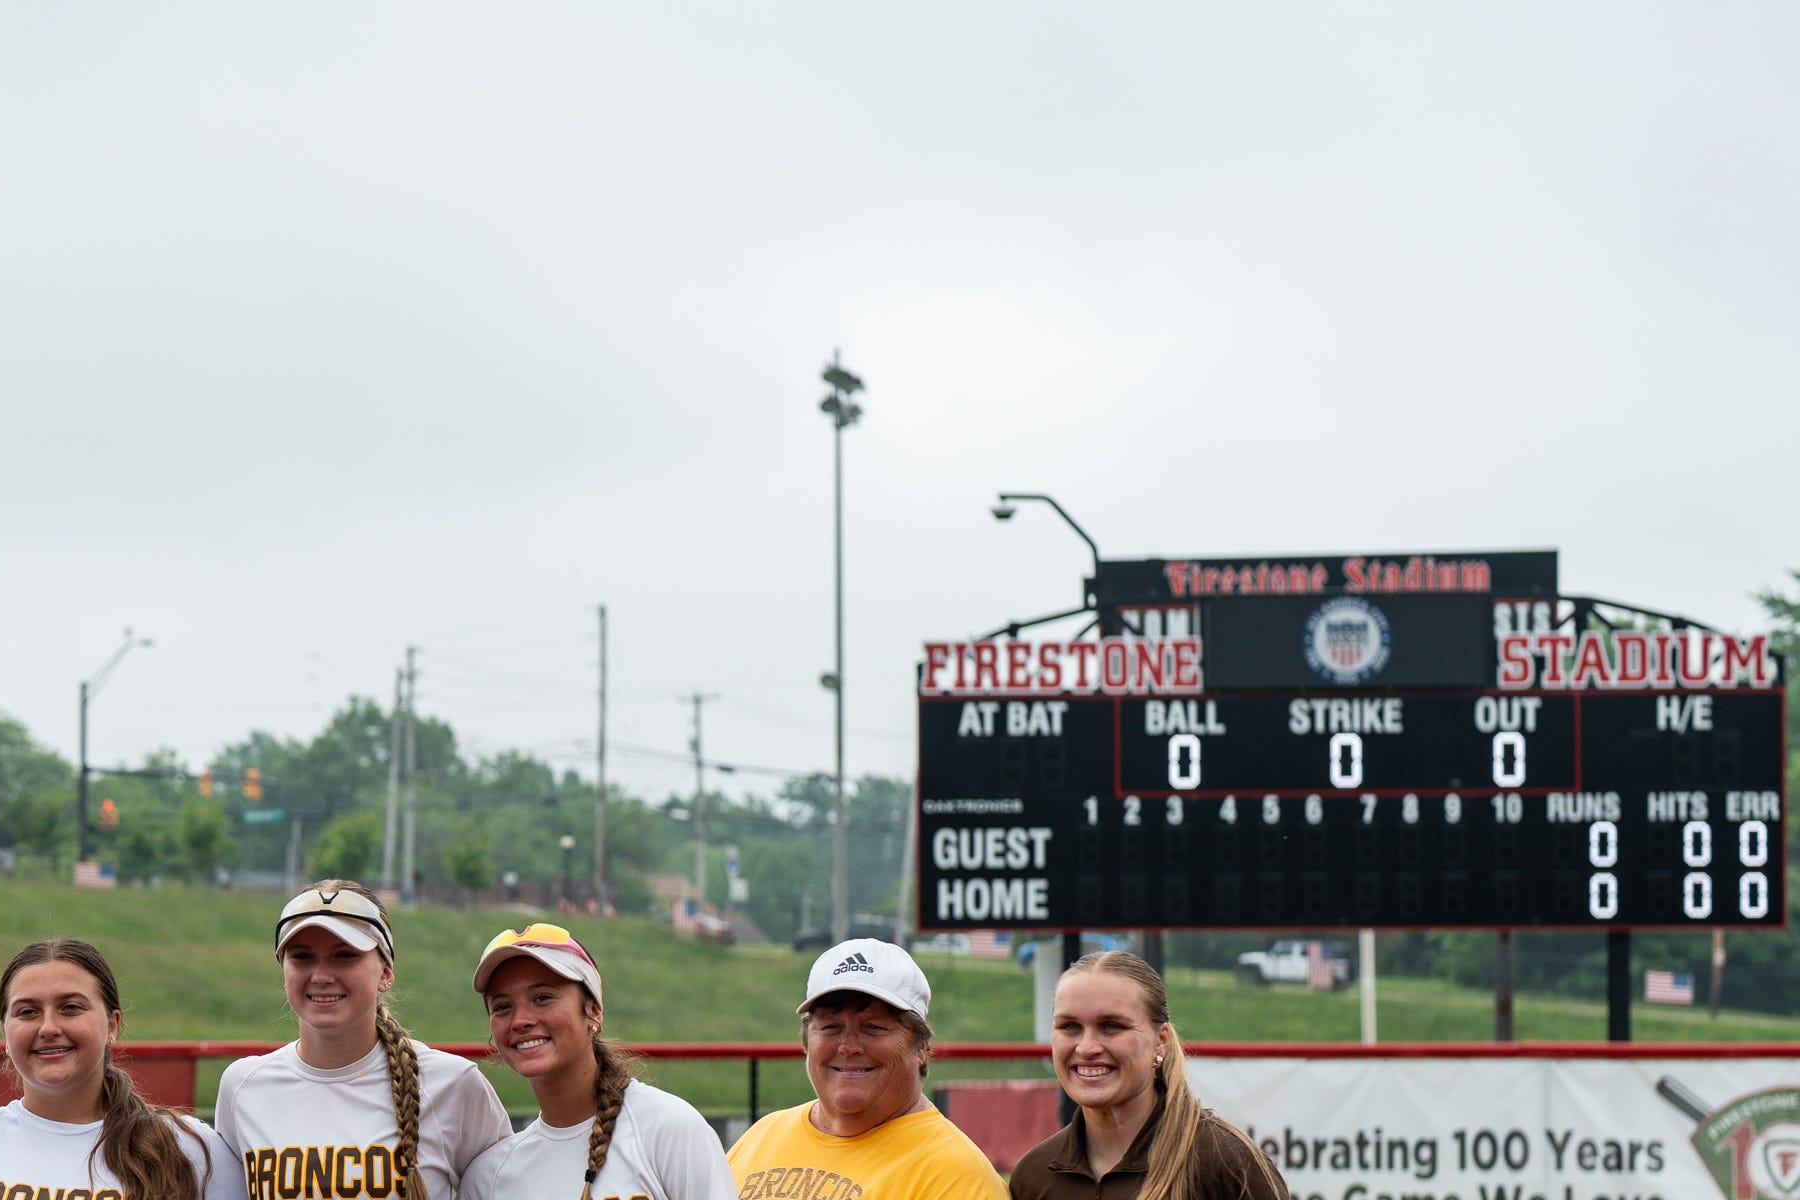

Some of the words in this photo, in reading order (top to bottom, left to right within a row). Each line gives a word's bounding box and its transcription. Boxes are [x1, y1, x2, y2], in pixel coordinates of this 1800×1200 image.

[1164, 560, 1328, 597] Firestone
[1343, 556, 1491, 593] Stadium
[921, 637, 1202, 694] FIRESTONE
[1498, 630, 1772, 688] STADIUM
[958, 701, 1000, 737] AT
[1006, 701, 1068, 737] BAT
[1145, 700, 1226, 735] BALL
[1288, 698, 1403, 734] STRIKE
[1474, 696, 1542, 732] OUT
[1656, 695, 1713, 734] H/E
[1168, 734, 1200, 790] 0
[1330, 733, 1363, 788] 0
[1493, 731, 1526, 788] 0
[1084, 795, 1098, 826] 1
[1124, 796, 1142, 826] 2
[1166, 795, 1184, 826] 3
[1219, 794, 1238, 825] 4
[1262, 794, 1280, 825] 5
[1305, 794, 1323, 825] 6
[1359, 793, 1378, 825] 7
[1402, 793, 1420, 825] 8
[1444, 792, 1462, 825] 9
[1491, 792, 1523, 824] 10
[1546, 792, 1621, 823] RUNS
[1647, 791, 1709, 822] HITS
[1725, 790, 1780, 822] ERR
[933, 827, 1052, 869] GUEST
[1589, 821, 1618, 867] 0
[1683, 820, 1712, 867] 0
[1739, 820, 1768, 867] 0
[937, 878, 1049, 919] HOME
[1589, 872, 1618, 919] 0
[1683, 872, 1712, 919] 0
[1739, 871, 1768, 919] 0
[833, 963, 874, 976] adidas
[1453, 1128, 1530, 1171] 100
[1545, 1128, 1664, 1172] Years
